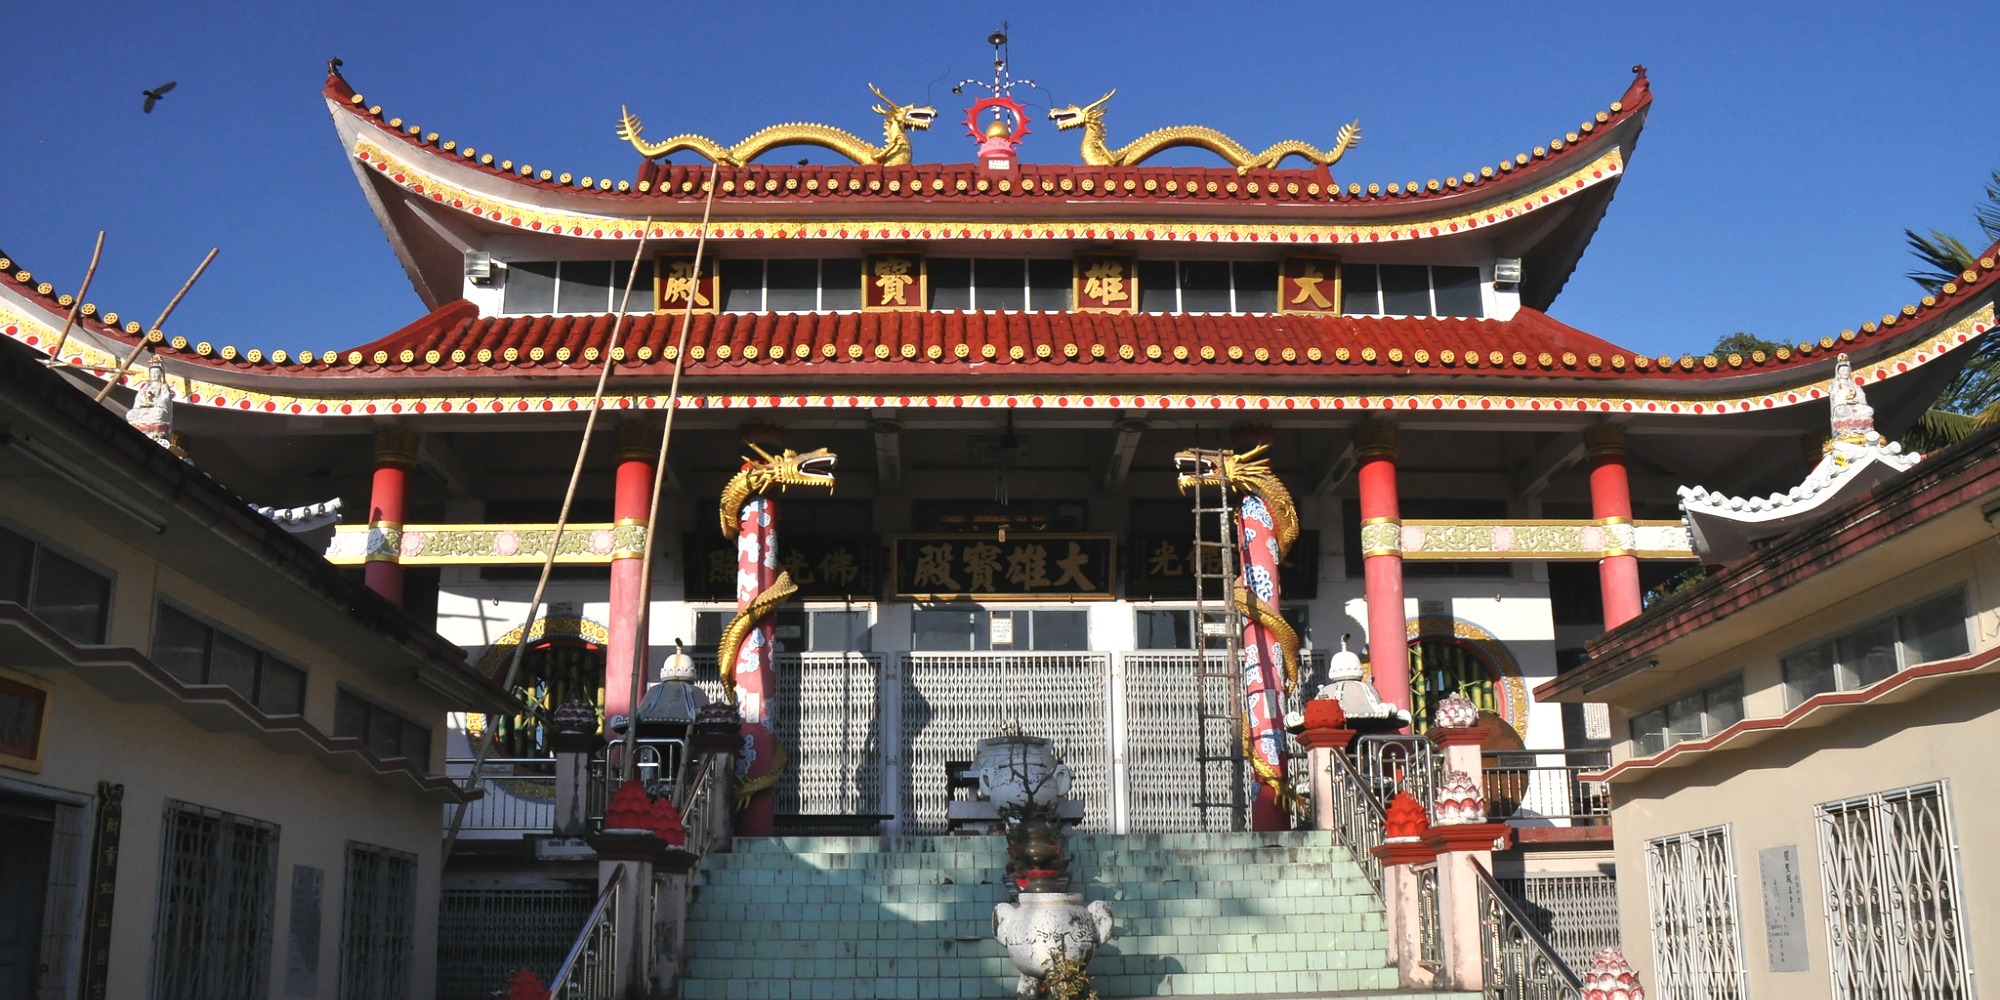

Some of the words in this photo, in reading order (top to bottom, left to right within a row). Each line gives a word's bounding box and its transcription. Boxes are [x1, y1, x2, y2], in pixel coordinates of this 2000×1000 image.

[664, 260, 710, 306] 殿
[875, 258, 913, 305] 寶
[1084, 261, 1128, 306] 雄
[1291, 263, 1332, 308] 大
[913, 541, 1096, 592] 大雄寶殿
